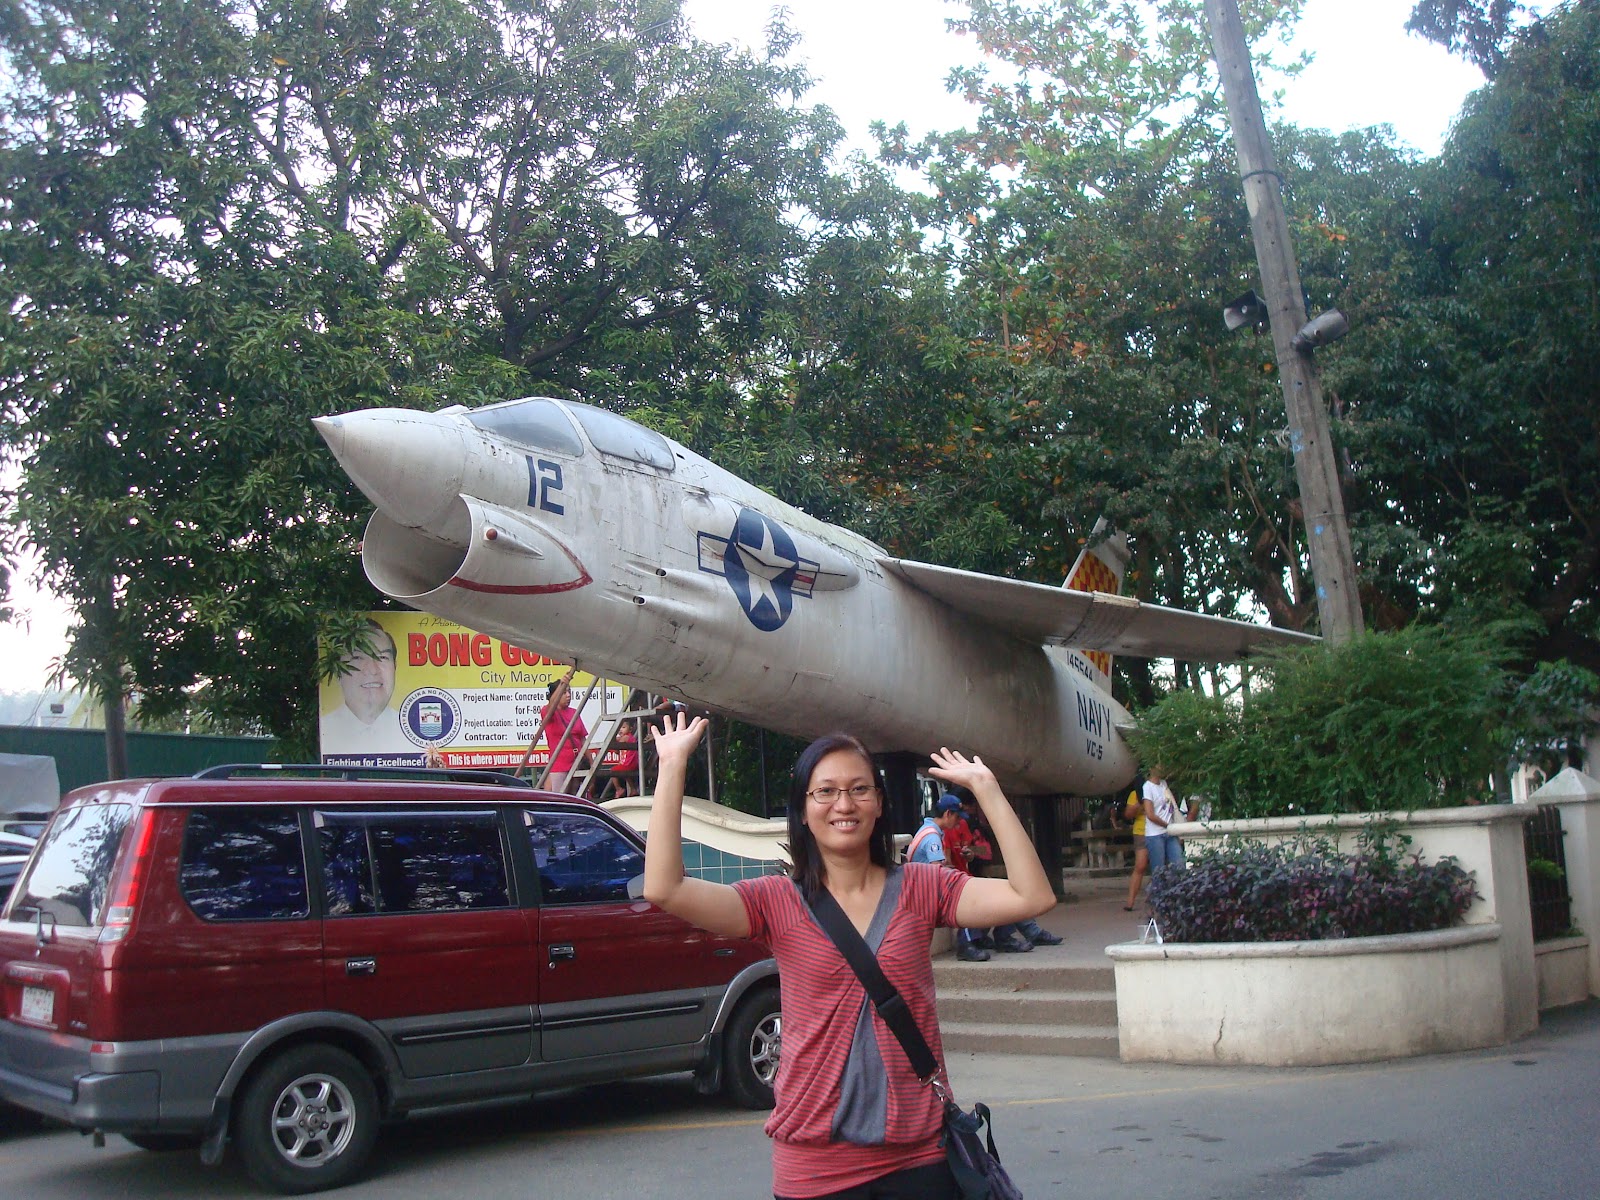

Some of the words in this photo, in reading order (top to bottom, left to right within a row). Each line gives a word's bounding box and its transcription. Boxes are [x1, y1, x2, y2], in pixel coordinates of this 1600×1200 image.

[525, 455, 564, 515] 12
[418, 617, 429, 627] A
[408, 632, 492, 667] BONG
[481, 671, 506, 686] City
[510, 671, 552, 685] Mayor
[402, 690, 426, 717] REPUBLIKA
[438, 692, 460, 717] PILIPINAS
[463, 693, 489, 703] Project
[489, 693, 513, 701] Name:
[514, 692, 545, 701] Concrete
[581, 691, 599, 700] Seel
[515, 705, 526, 715] for
[1076, 690, 1111, 742] NAVY
[464, 719, 486, 729] Project
[486, 718, 513, 727] Location:
[516, 717, 533, 727] Leo's
[464, 732, 508, 741] Contractor:
[1086, 738, 1103, 761] VC-5
[362, 758, 375, 767] for
[376, 757, 425, 767] Excellence!
[447, 753, 464, 766] This
[463, 753, 471, 765] is
[471, 753, 493, 765] where
[493, 753, 509, 766] your
[509, 753, 526, 764] taxe
